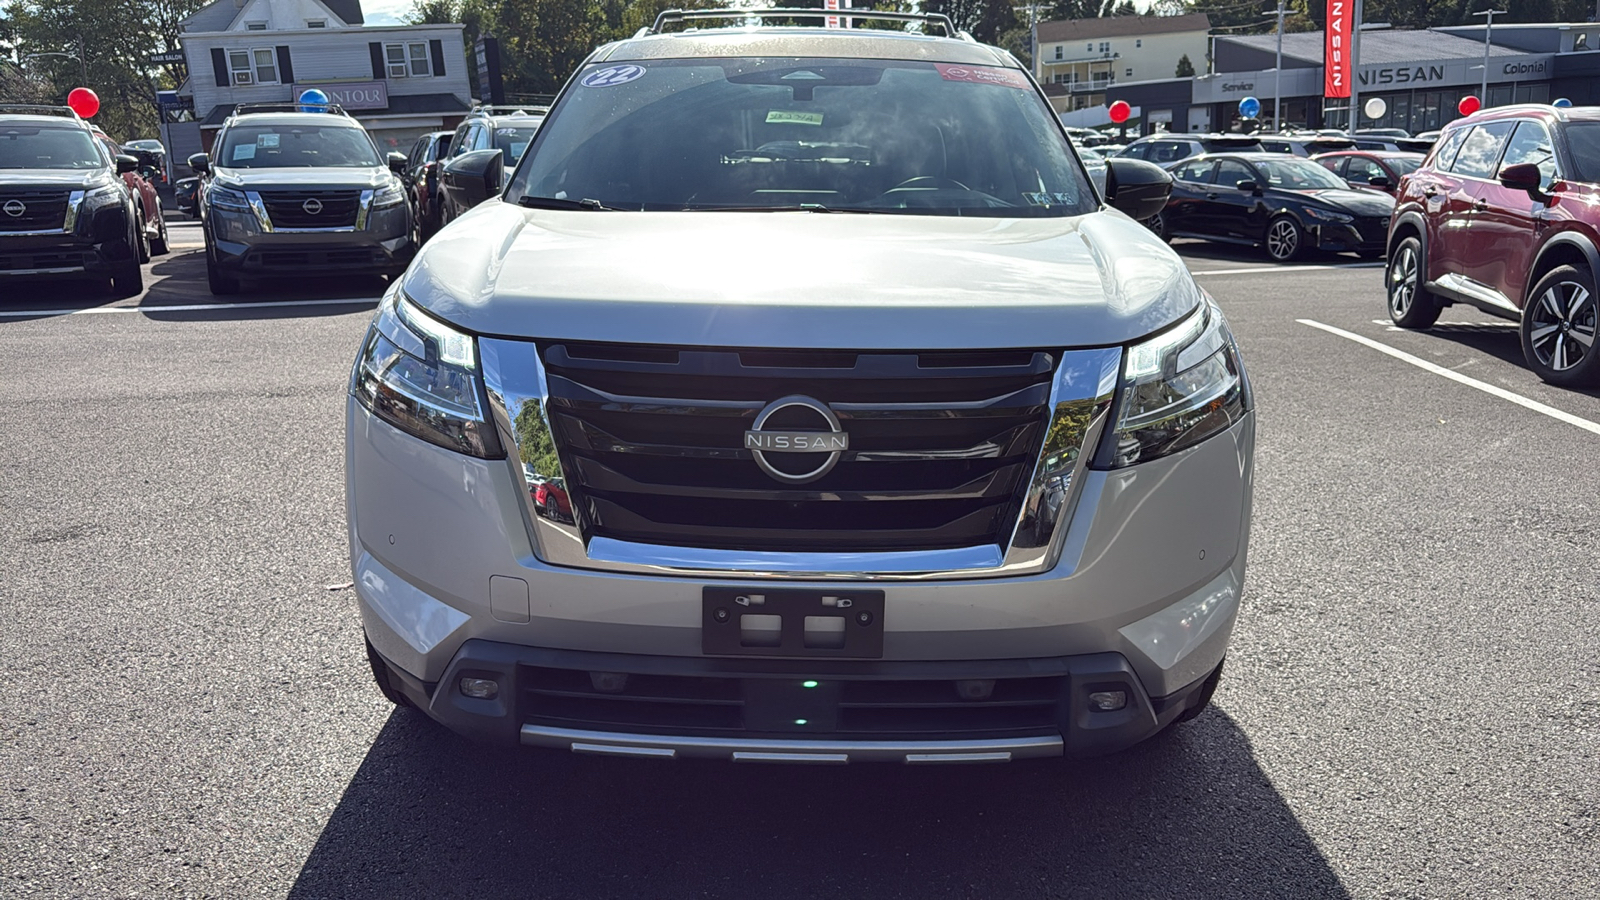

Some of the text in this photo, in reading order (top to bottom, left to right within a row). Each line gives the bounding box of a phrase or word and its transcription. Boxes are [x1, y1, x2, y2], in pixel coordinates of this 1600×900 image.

[1332, 2, 1343, 87] NISSAN
[588, 66, 638, 86] 22
[1358, 65, 1444, 85] NISSAN
[1503, 61, 1547, 75] Colonial
[1221, 81, 1254, 92] Service
[747, 434, 846, 449] NISSAN
